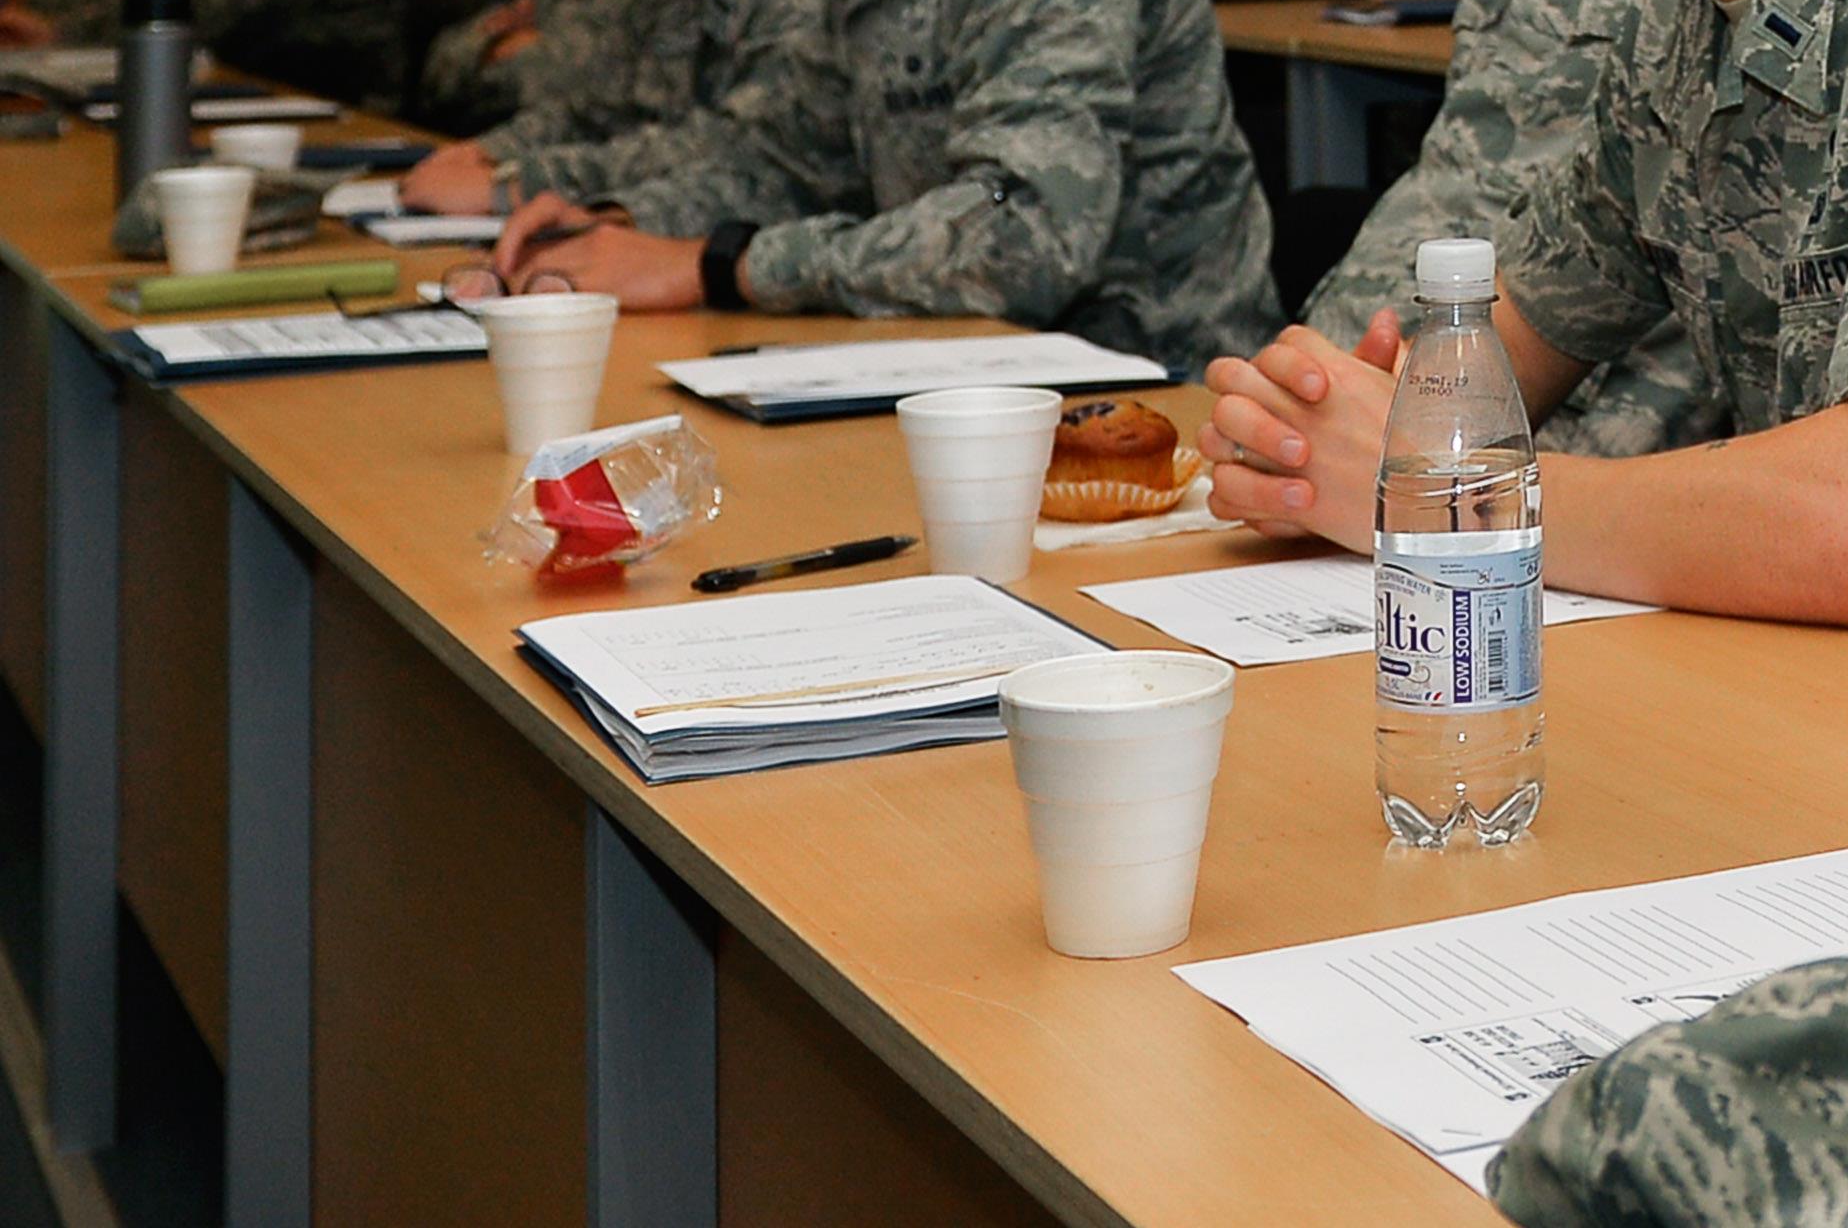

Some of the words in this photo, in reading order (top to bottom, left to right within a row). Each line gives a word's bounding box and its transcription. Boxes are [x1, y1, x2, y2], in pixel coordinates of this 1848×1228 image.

[1376, 590, 1446, 654] eltic
[1455, 595, 1470, 658] SODIUM
[1455, 660, 1470, 697] LOW
